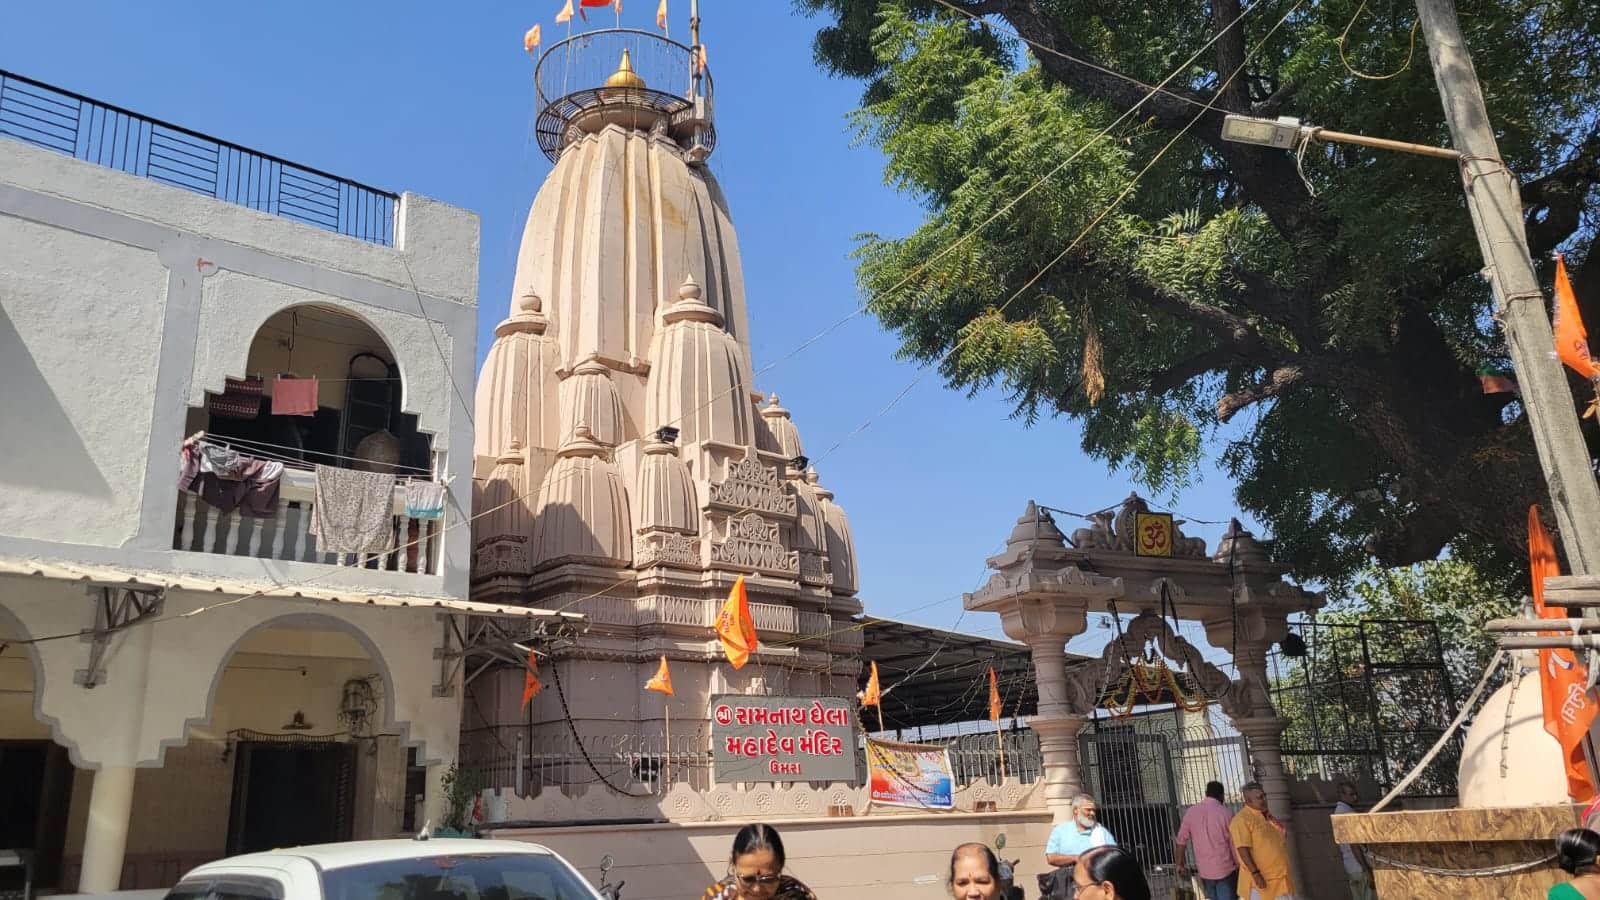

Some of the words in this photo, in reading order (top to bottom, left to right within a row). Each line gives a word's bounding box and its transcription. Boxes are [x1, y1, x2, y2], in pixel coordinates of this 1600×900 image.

[715, 705, 733, 725] શ્રી
[736, 707, 806, 726] રામનાથ
[810, 700, 848, 726] ઘેલા
[726, 729, 795, 757] મહાદેવ
[799, 729, 843, 756] મંદિર
[769, 760, 802, 775] ઉમરા
